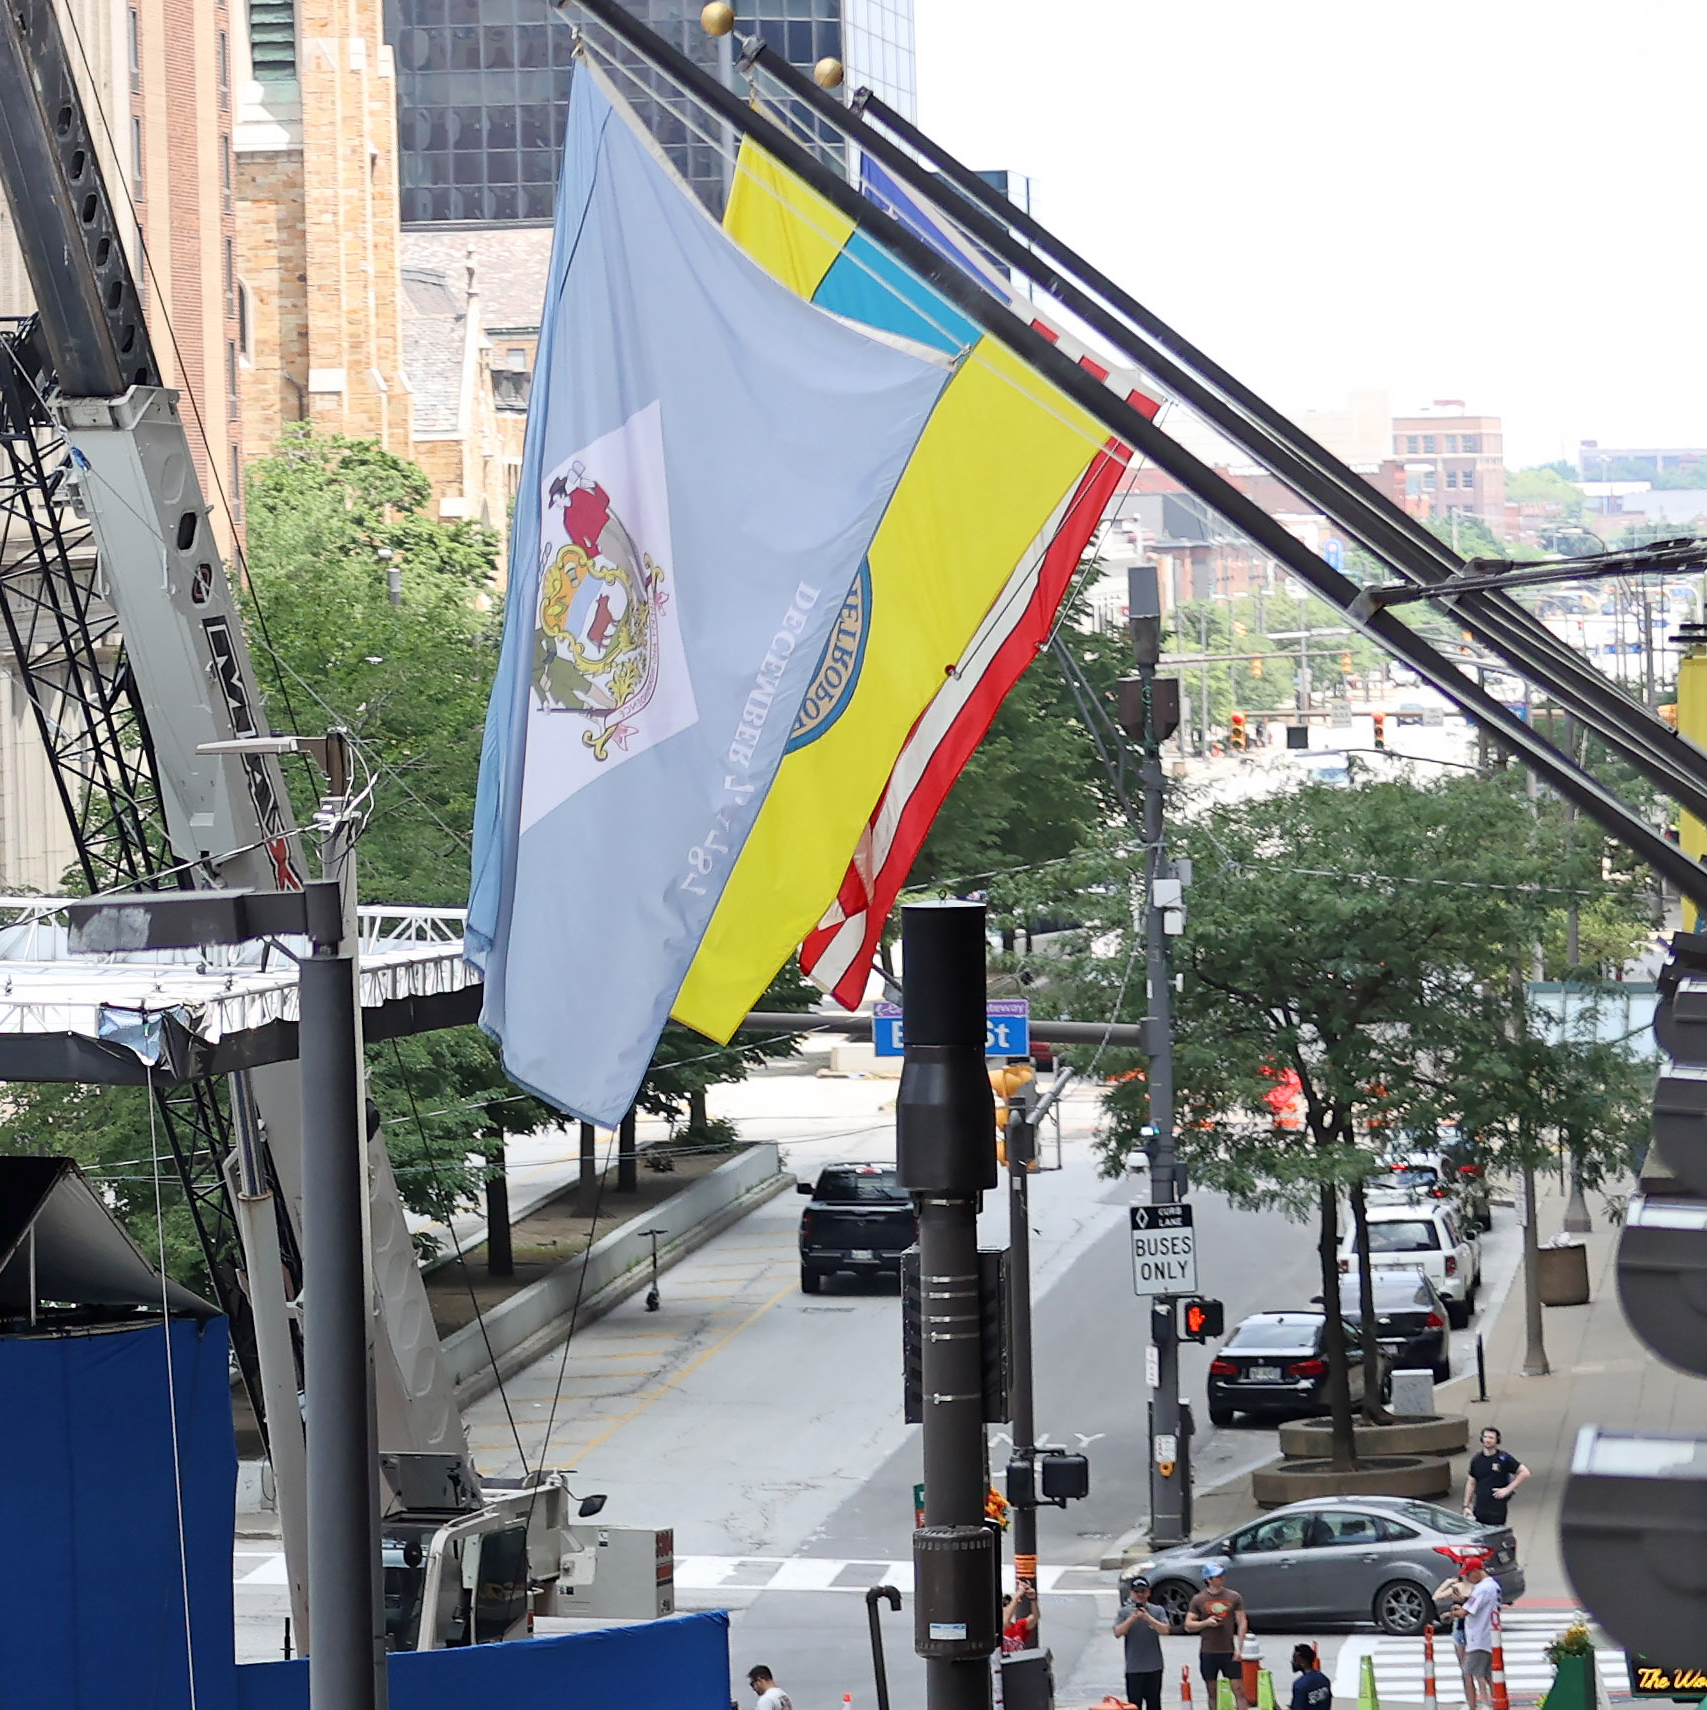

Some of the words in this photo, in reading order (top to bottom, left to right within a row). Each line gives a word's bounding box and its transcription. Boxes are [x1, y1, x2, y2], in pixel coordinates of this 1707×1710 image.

[1158, 1207, 1182, 1216] CURB
[1158, 1217, 1182, 1227] LANE
[1135, 1236, 1192, 1257] BUSES
[1141, 1260, 1187, 1280] ONLY
[1638, 1667, 1670, 1689] The
